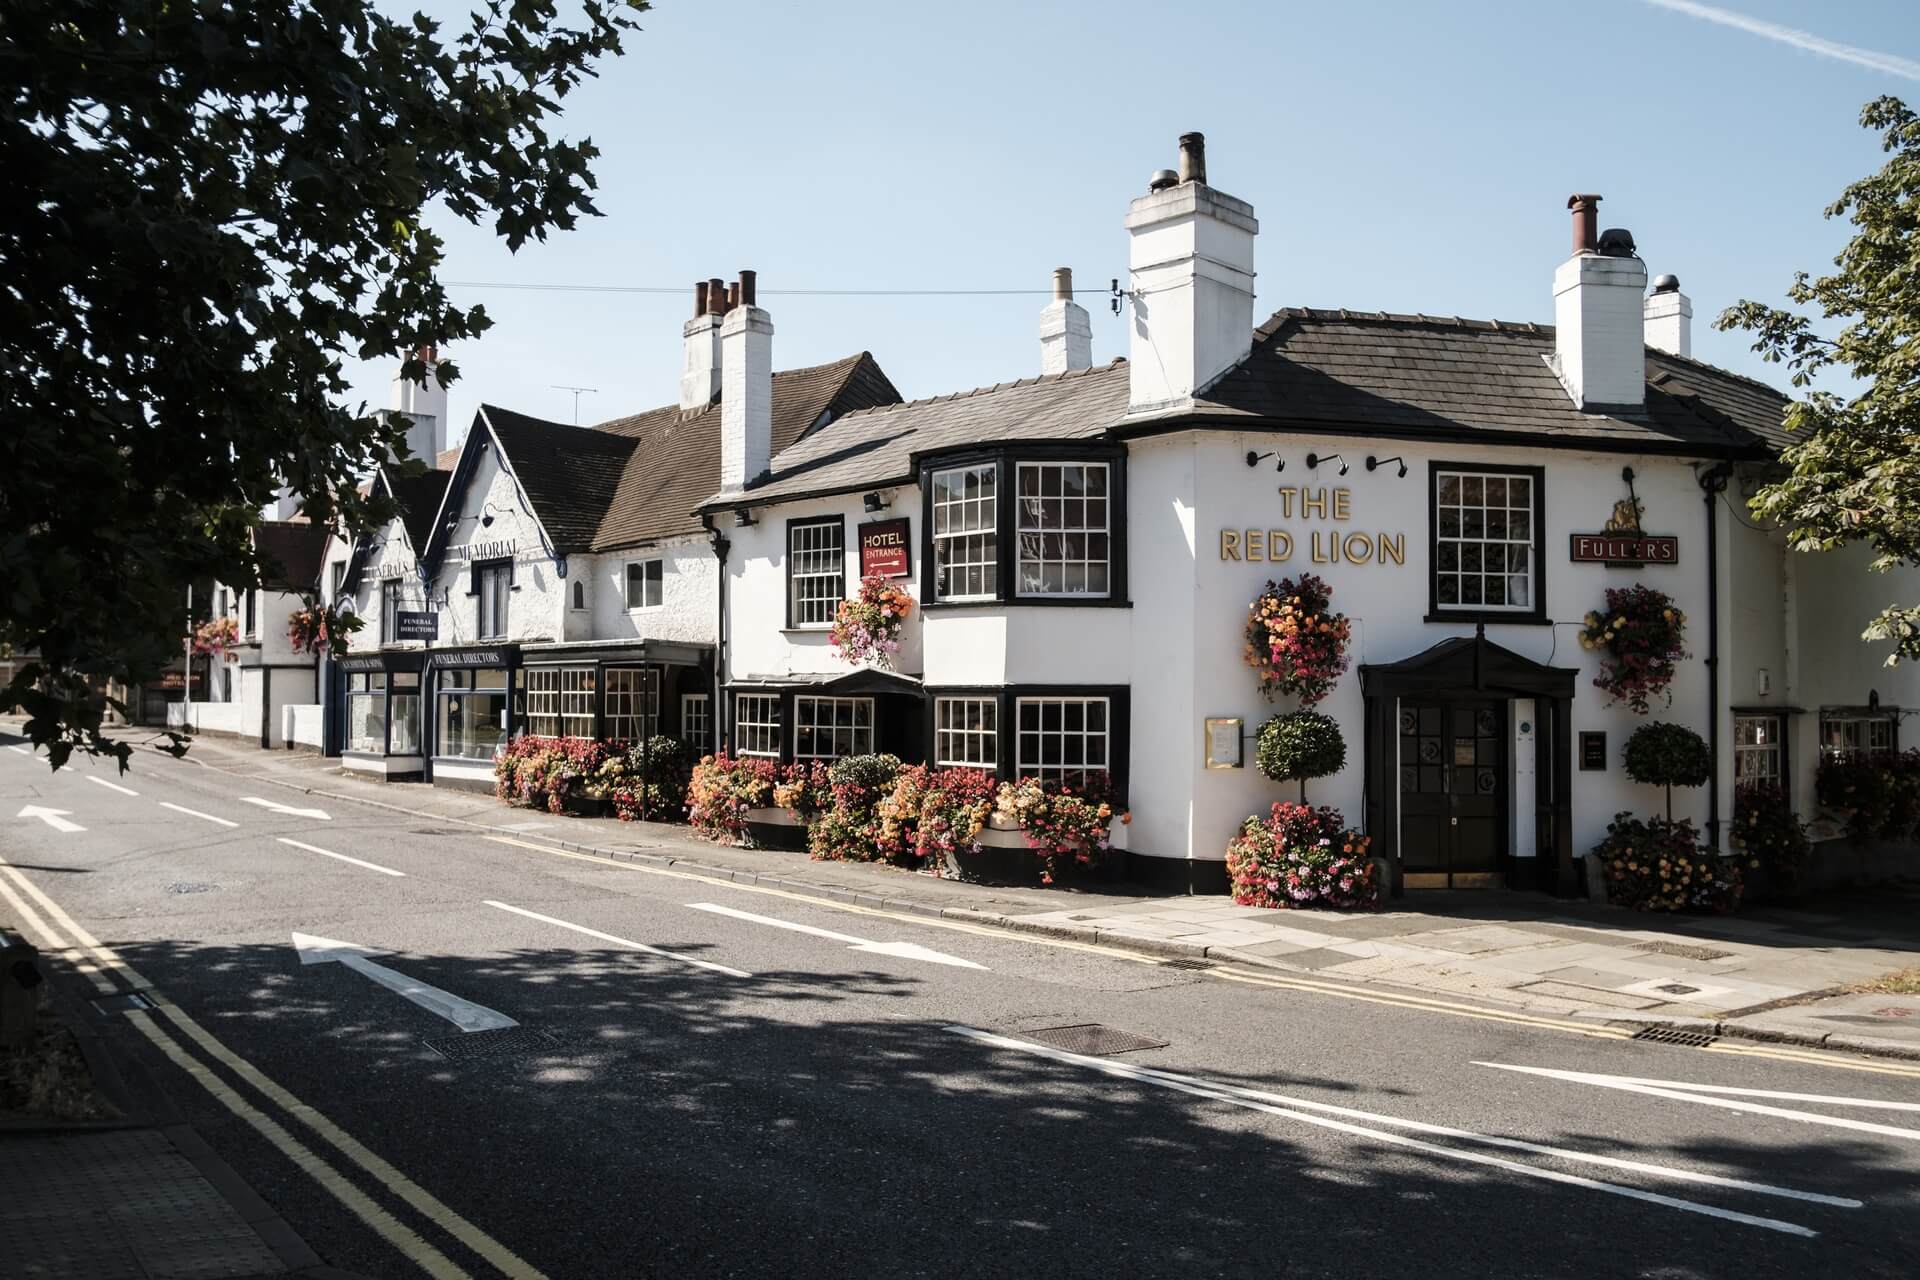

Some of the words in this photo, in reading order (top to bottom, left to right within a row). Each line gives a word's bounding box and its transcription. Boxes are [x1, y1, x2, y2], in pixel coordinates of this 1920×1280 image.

[1279, 487, 1351, 520] THE
[863, 532, 905, 548] HOTEL
[1220, 529, 1295, 562] RED
[1312, 531, 1406, 565] LION
[458, 538, 520, 561] MEMORIAL
[865, 547, 903, 559] ENTRANCE
[403, 618, 433, 626] FUNERAL
[434, 653, 463, 665] FUNERAL
[463, 652, 500, 663] DIRECTORS
